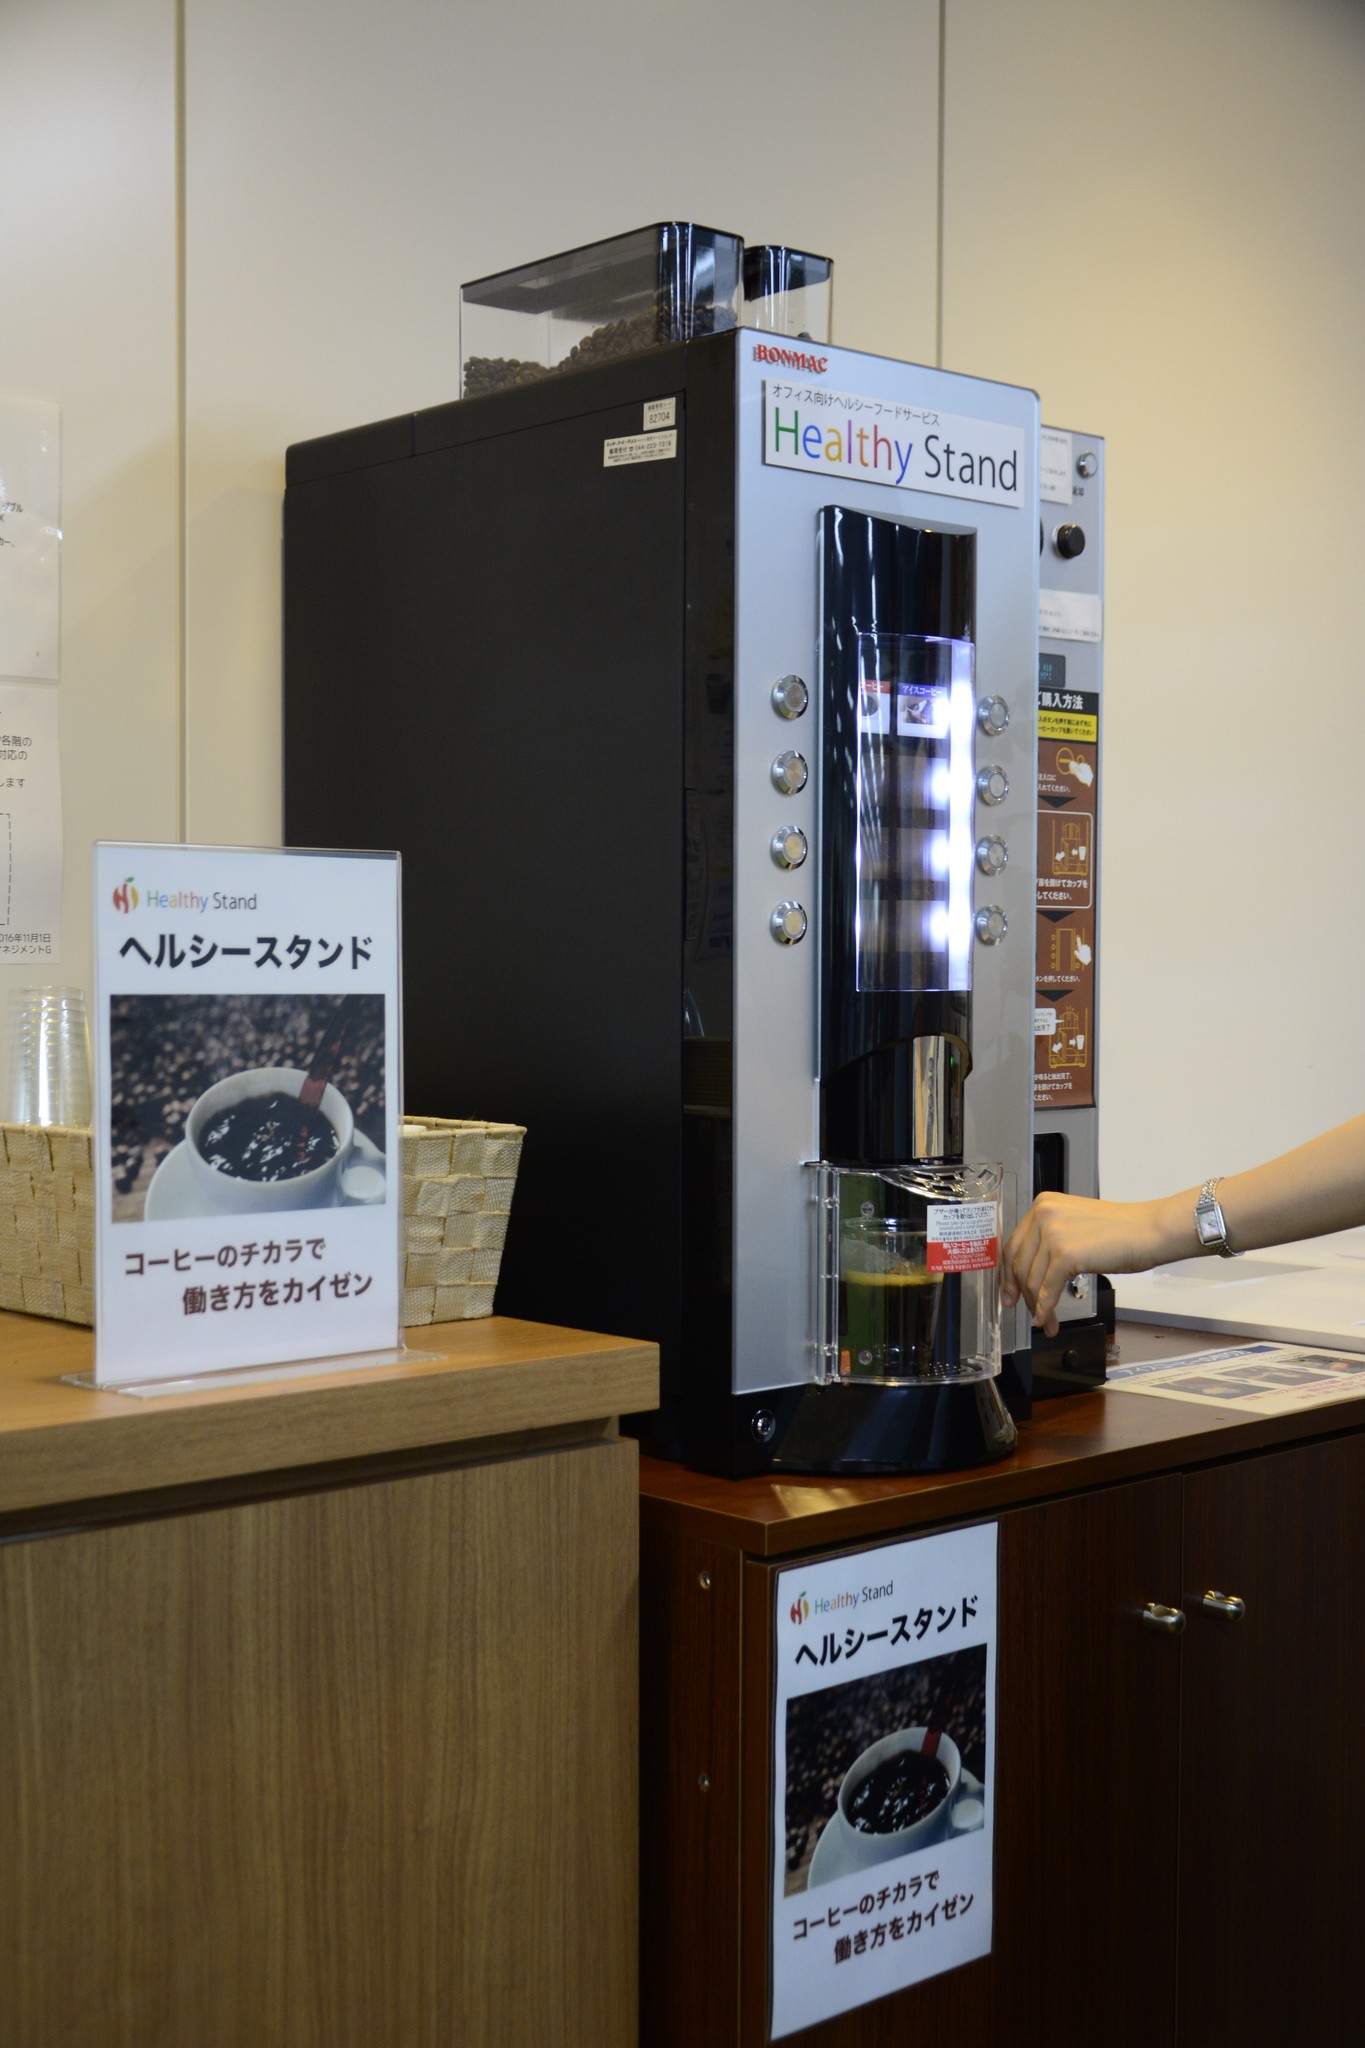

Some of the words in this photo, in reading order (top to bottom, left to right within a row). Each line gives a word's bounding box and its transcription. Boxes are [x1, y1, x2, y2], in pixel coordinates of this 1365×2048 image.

[756, 343, 828, 373] BONMAC
[772, 384, 941, 427] オフィス向けヘルシーフードサービス
[774, 406, 914, 485] Healthy
[924, 434, 1018, 492] Stand
[902, 685, 943, 697] アイスコーヒー
[0, 734, 32, 747] 各階の
[147, 890, 209, 913] Healthy
[212, 892, 258, 911] Stand
[0, 945, 52, 954] ネジメントG
[119, 933, 373, 970] ヘルシースタンド
[124, 1237, 326, 1276] コーヒーのチカラで
[181, 1271, 373, 1316] 働き方をカイゼン
[814, 1591, 860, 1615] Healthy
[861, 1579, 894, 1604] Stand
[794, 1595, 979, 1667] ヘルシースタンド
[793, 1869, 940, 1941] コーヒーのチカラで
[833, 1893, 975, 1965] 働き方をカイゼン
